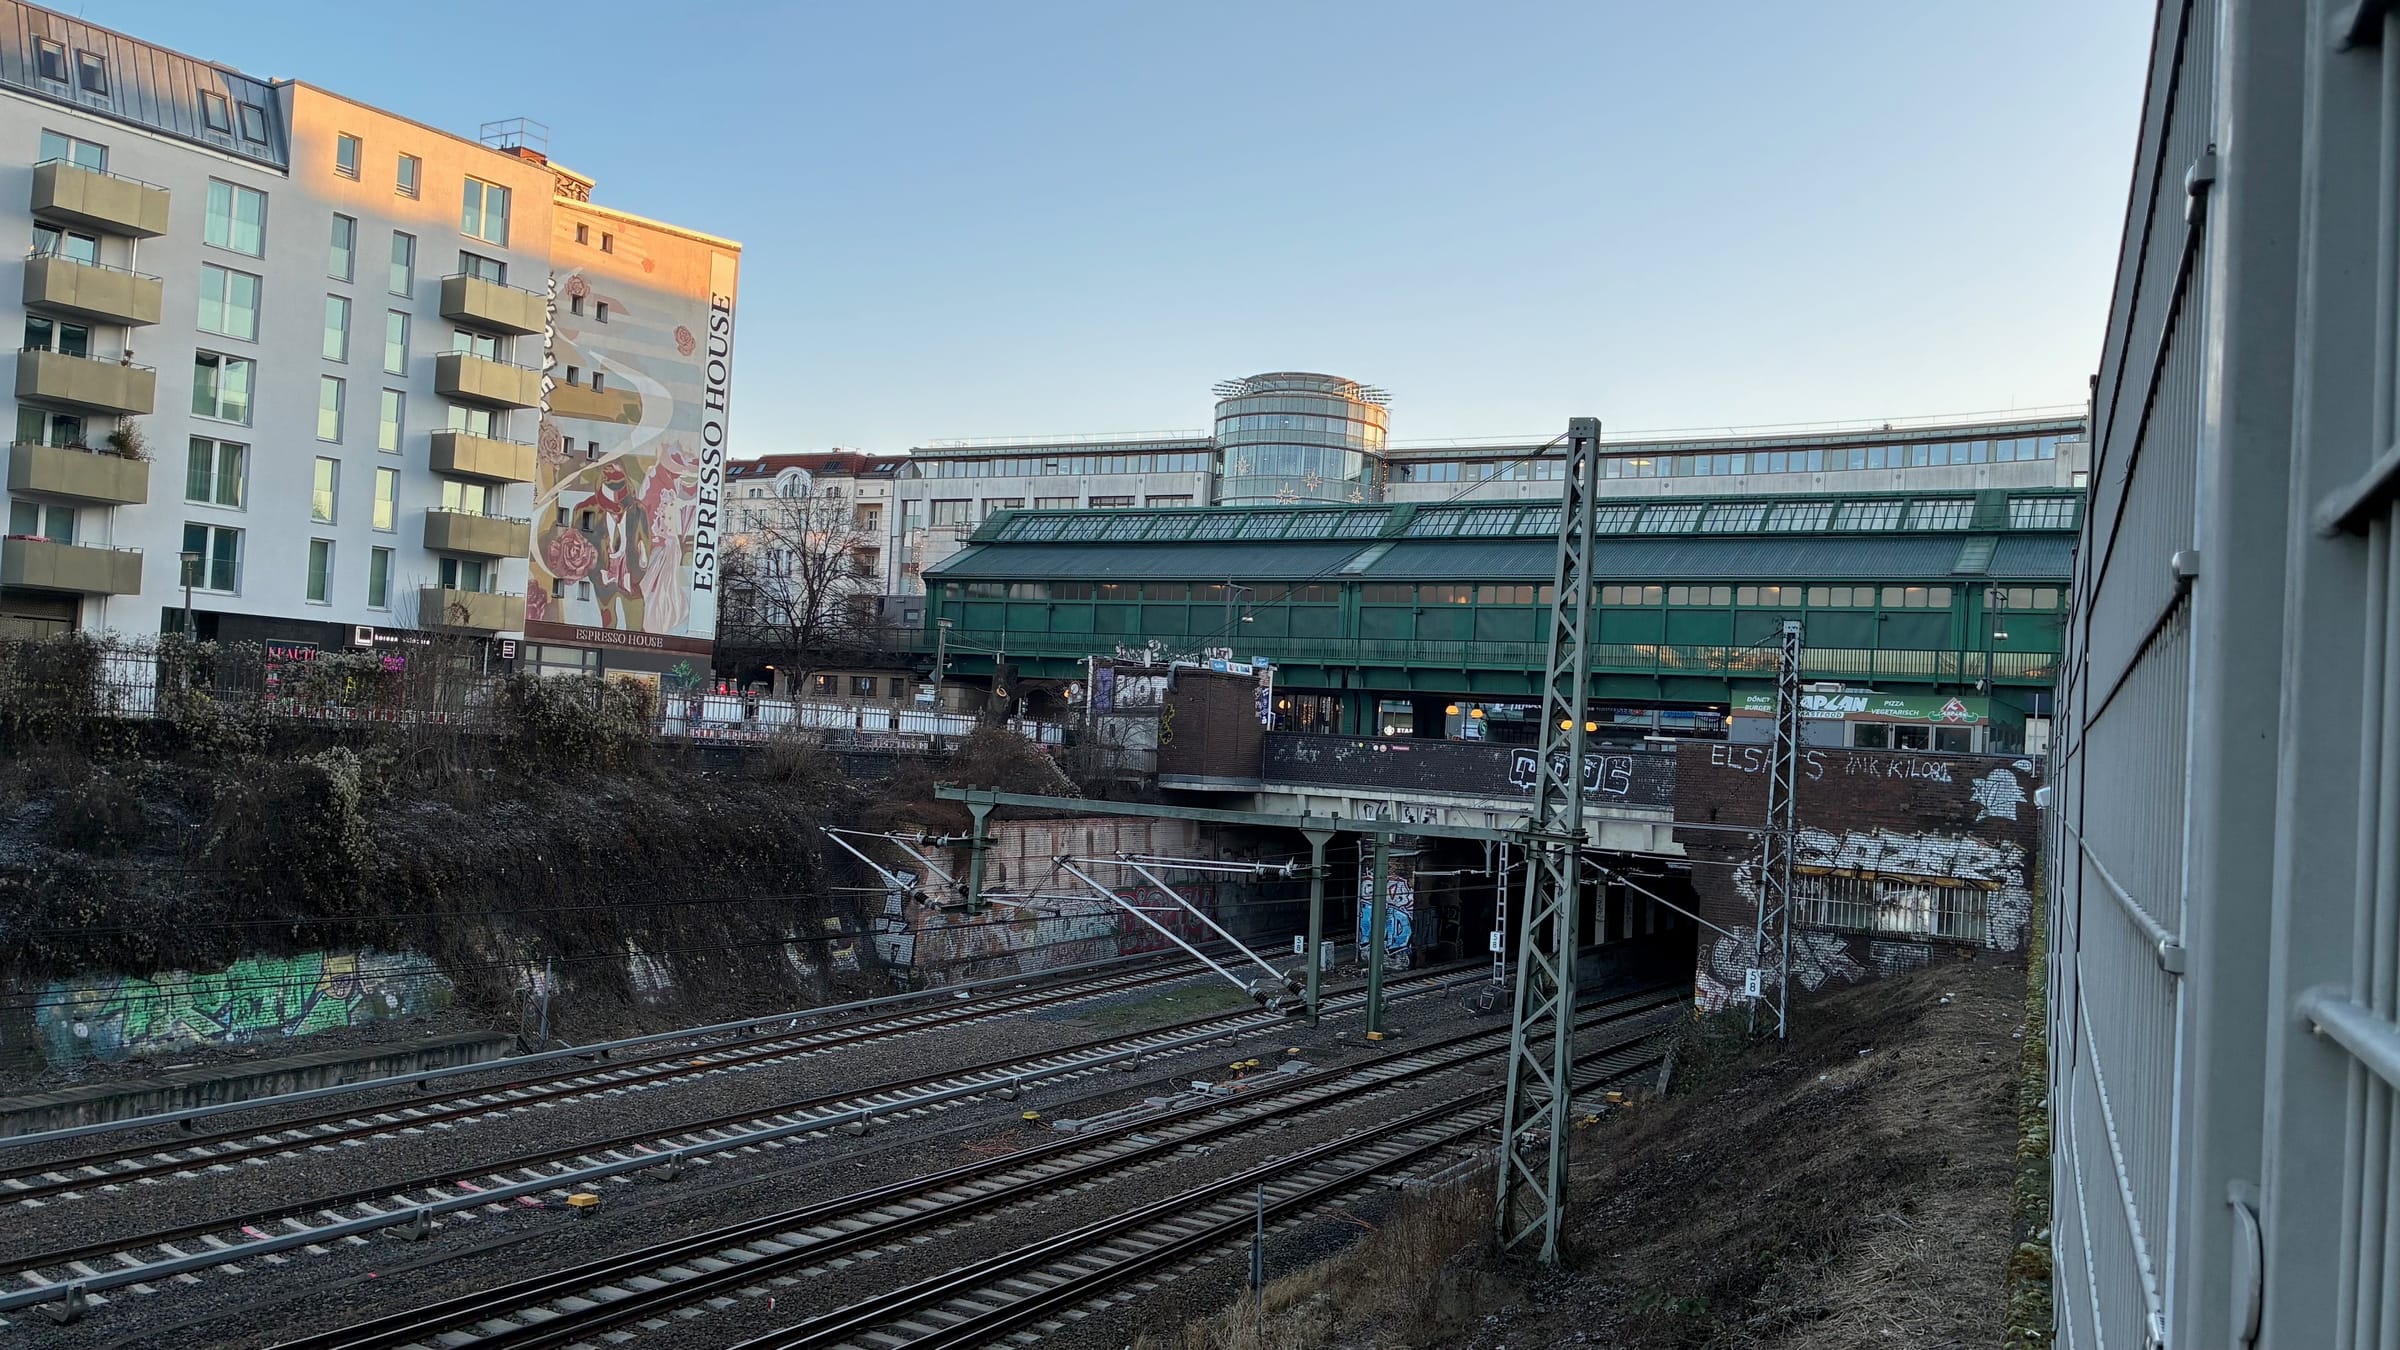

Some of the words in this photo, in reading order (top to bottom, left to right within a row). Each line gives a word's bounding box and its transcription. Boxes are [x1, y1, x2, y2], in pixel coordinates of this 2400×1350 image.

[705, 291, 731, 413] HOUSE
[693, 420, 723, 593] ESPRESSO
[575, 628, 626, 644] ESPRESSO
[628, 634, 664, 648] HOUSE
[1799, 694, 1868, 712] APLAN
[1871, 708, 1920, 716] VEGETARISCH
[1750, 970, 1757, 981] 5
[1749, 982, 1756, 992] 8
